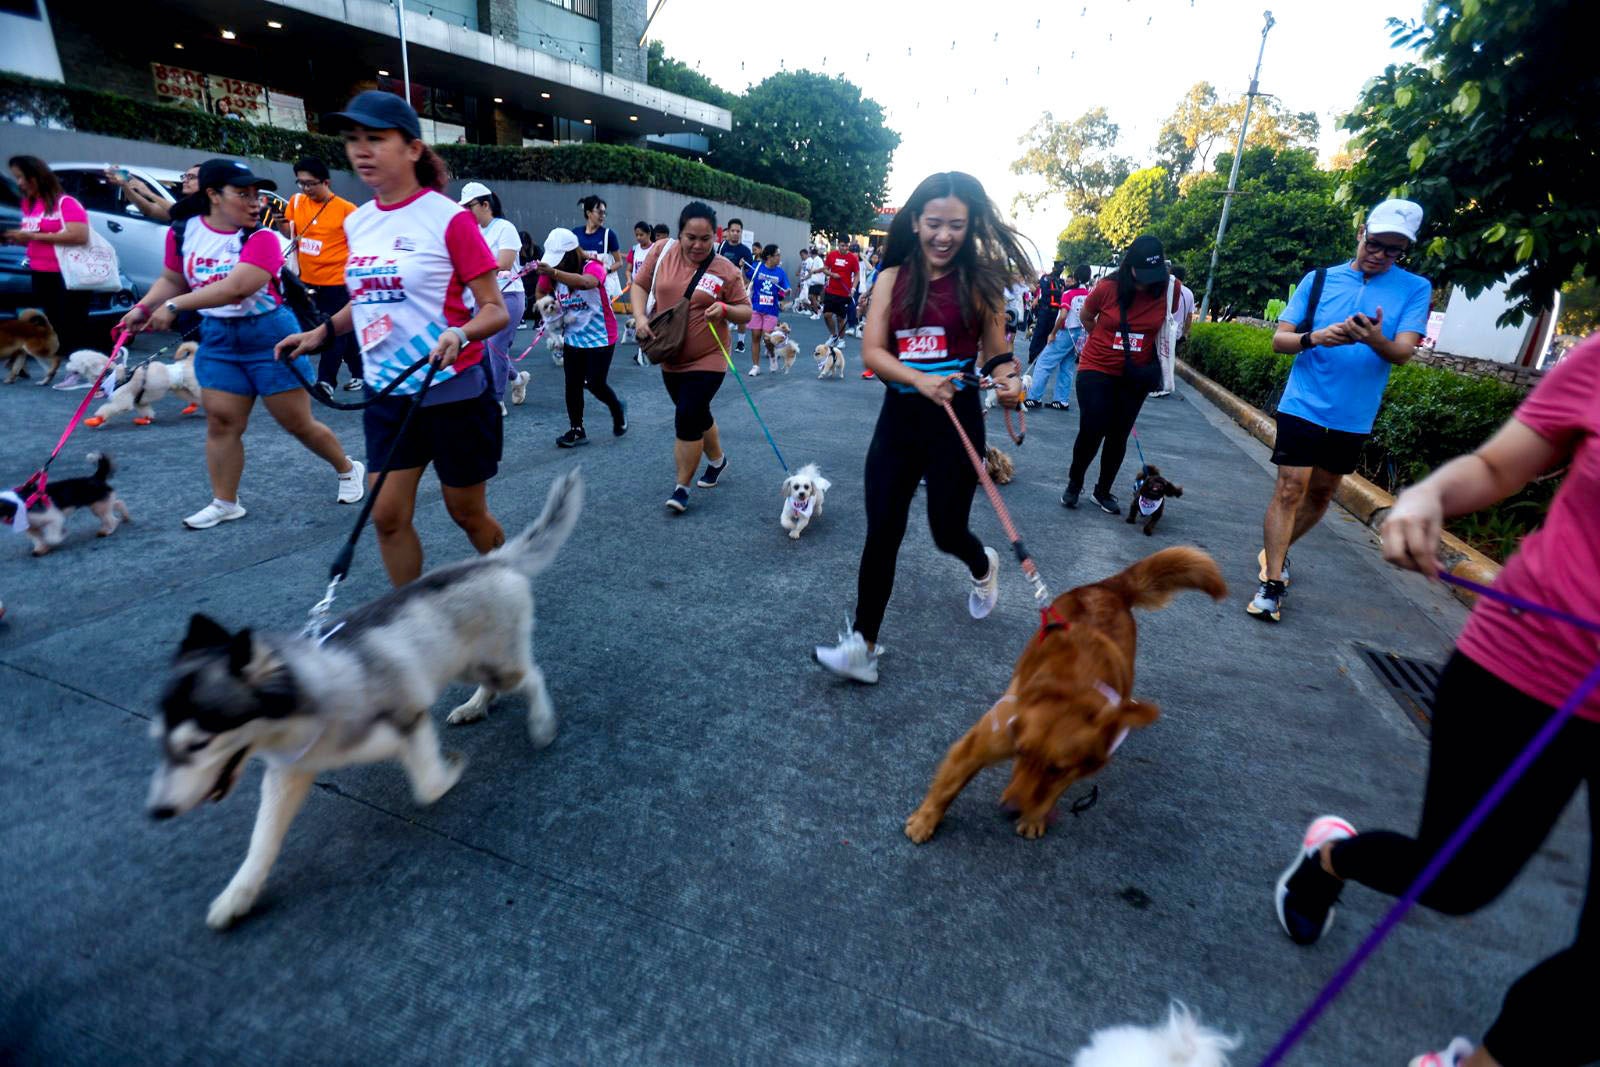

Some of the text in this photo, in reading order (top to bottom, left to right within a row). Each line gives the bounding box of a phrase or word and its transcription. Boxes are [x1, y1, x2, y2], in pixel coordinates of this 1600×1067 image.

[196, 257, 219, 268] PET
[350, 255, 379, 267] PET
[361, 276, 405, 291] WALK
